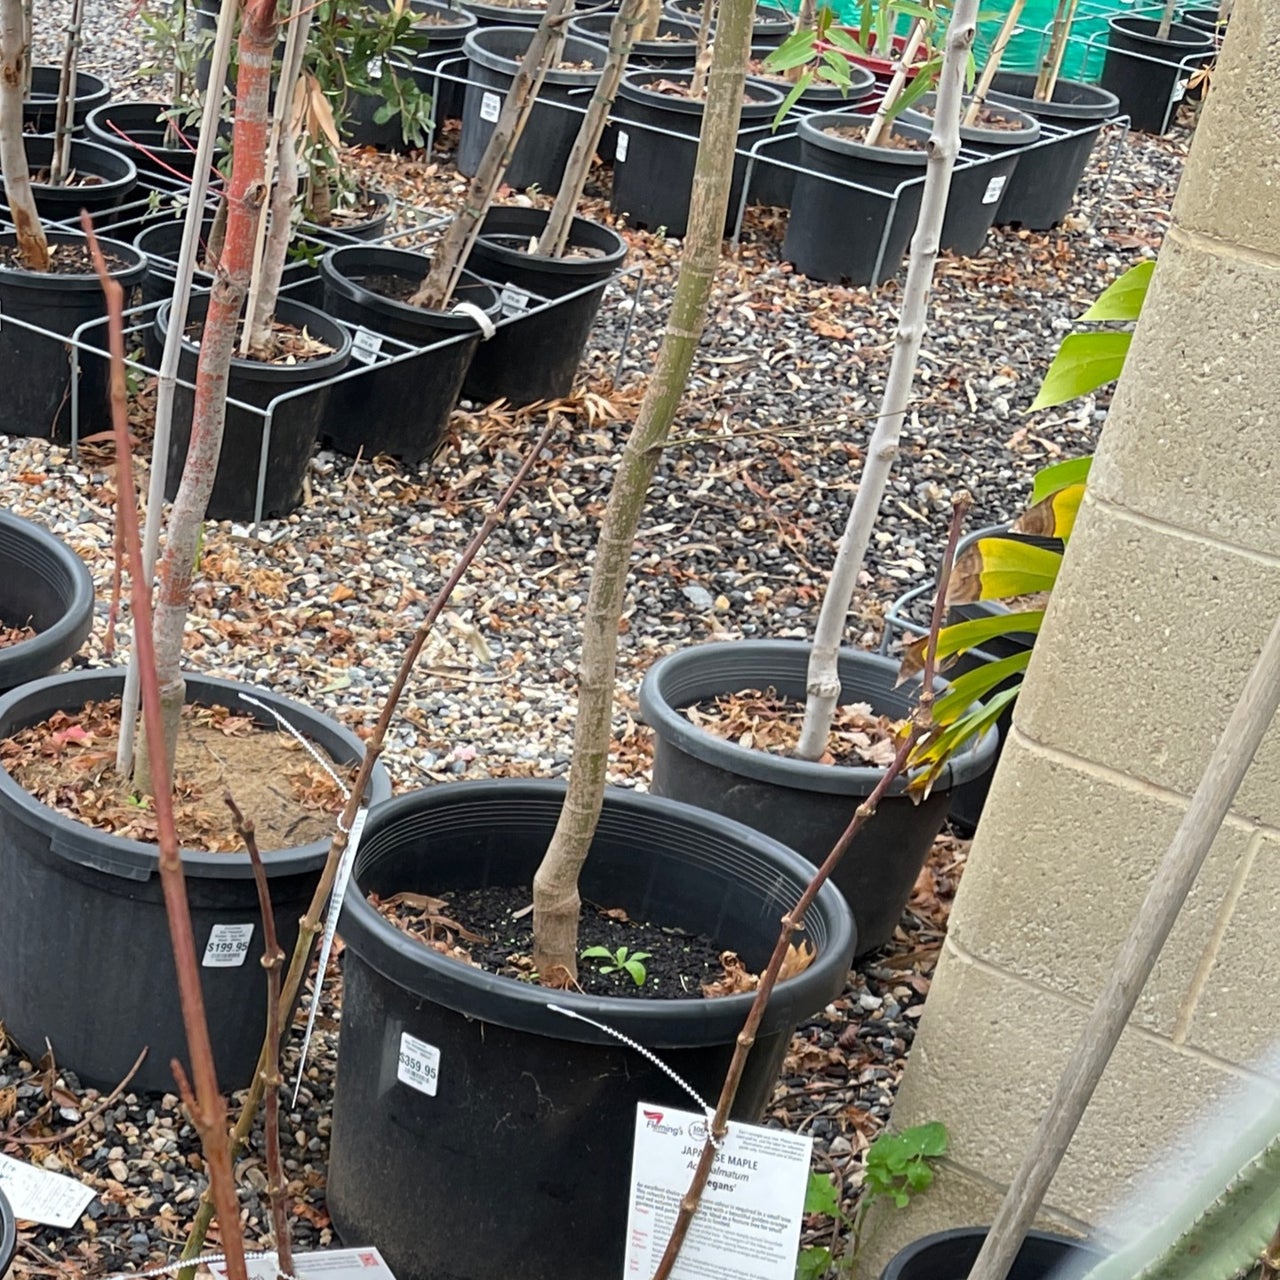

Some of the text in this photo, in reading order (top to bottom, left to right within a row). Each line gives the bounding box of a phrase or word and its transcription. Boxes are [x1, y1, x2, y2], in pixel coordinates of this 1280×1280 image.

[207, 942, 249, 953] $199.95
[400, 1052, 437, 1080] $359.95
[646, 1120, 684, 1137] Fleming's
[727, 1155, 759, 1171] MAPLE
[710, 1166, 750, 1182] almatum
